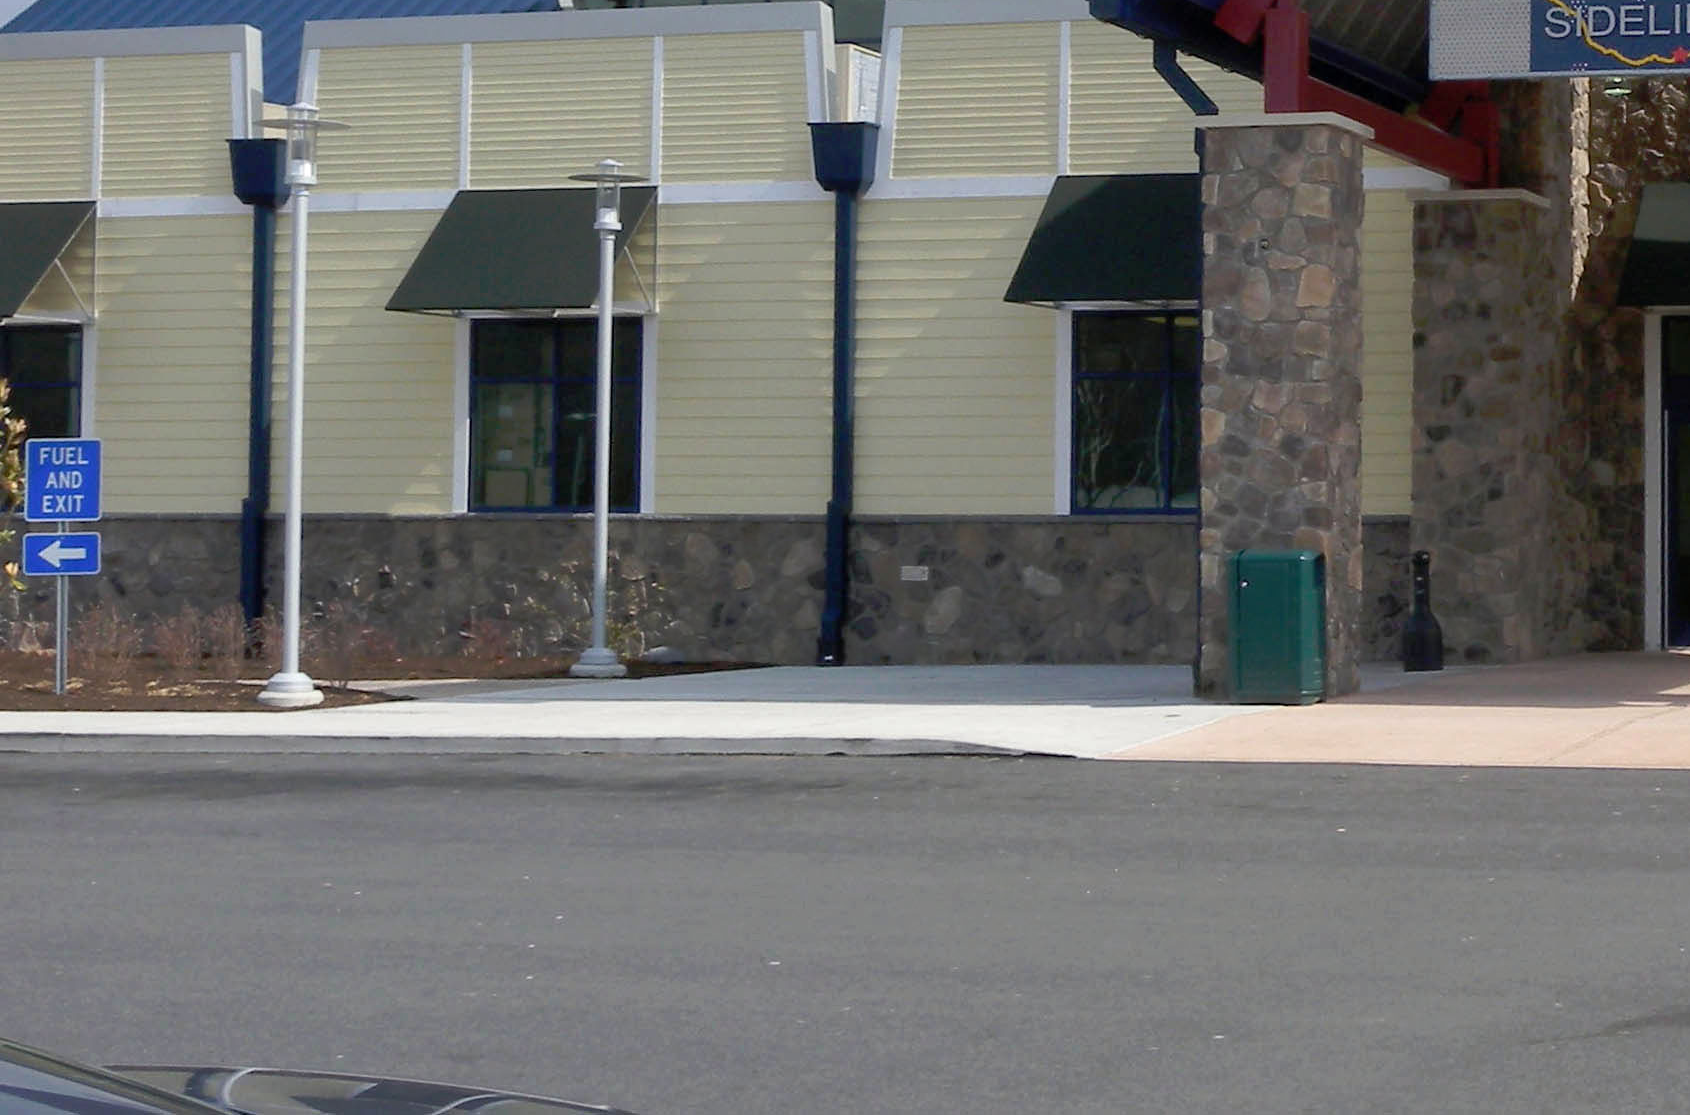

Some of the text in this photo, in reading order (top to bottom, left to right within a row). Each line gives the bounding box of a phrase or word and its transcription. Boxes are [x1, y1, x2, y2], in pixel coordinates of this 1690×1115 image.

[39, 446, 89, 466] FUEL
[44, 470, 83, 489] AND
[42, 494, 85, 514] EXIT
